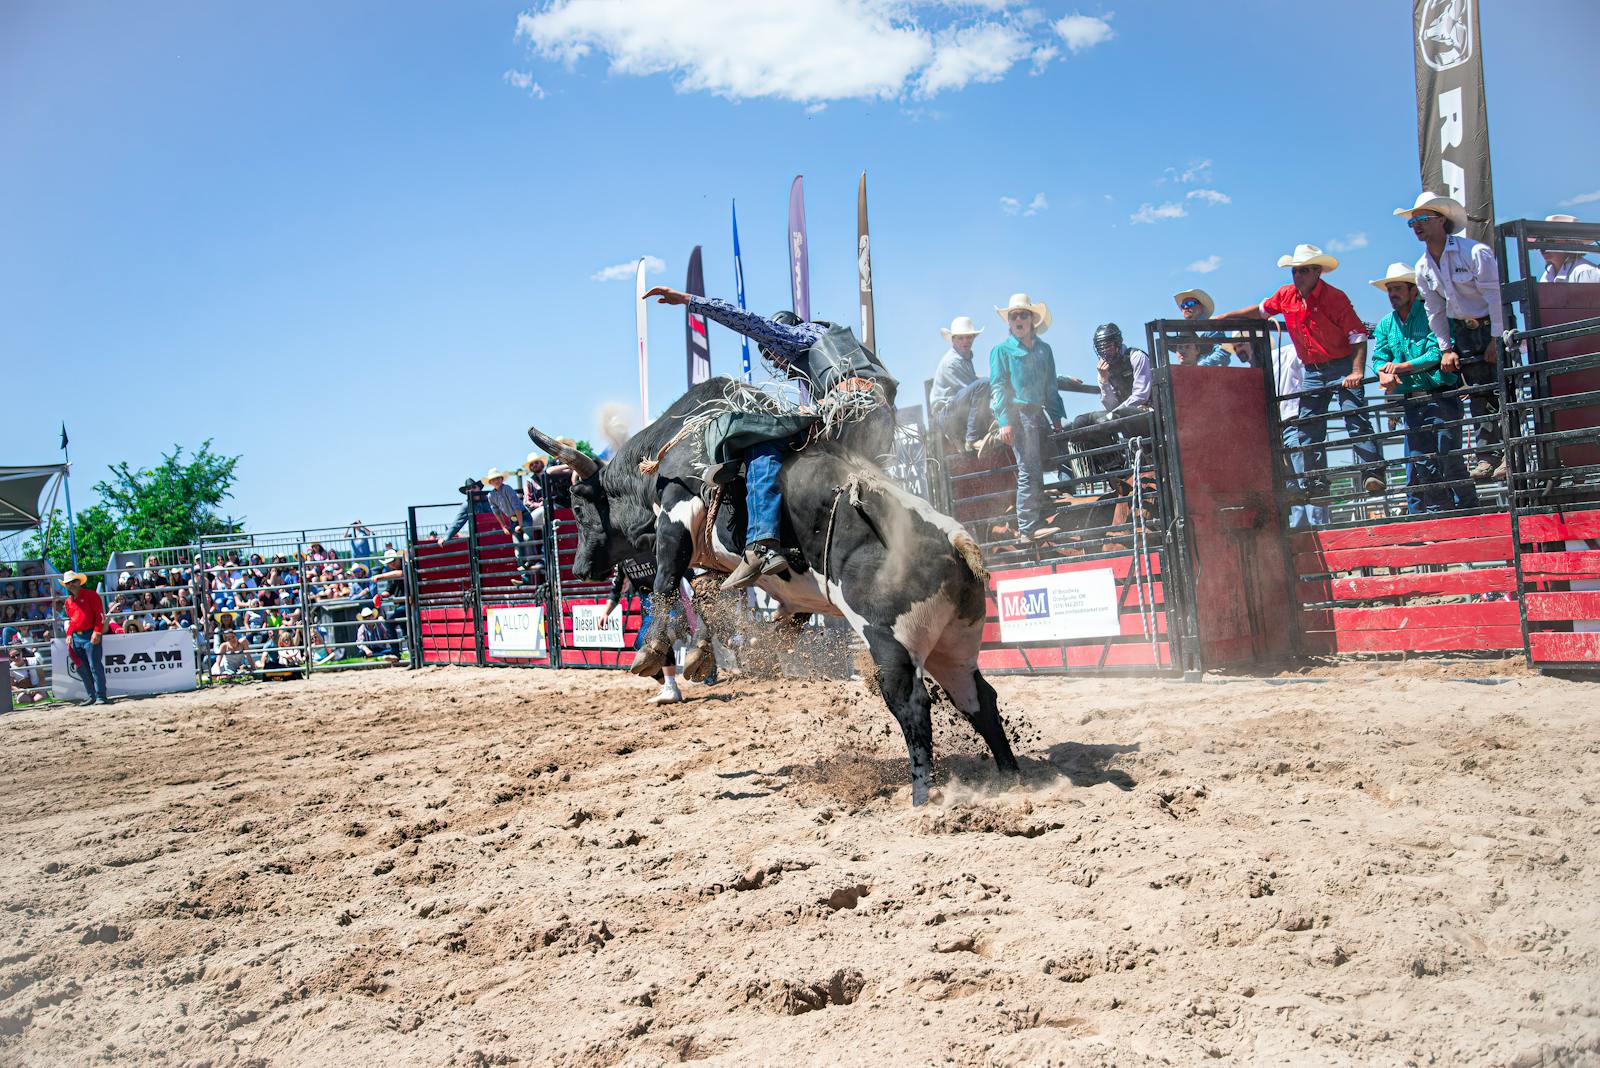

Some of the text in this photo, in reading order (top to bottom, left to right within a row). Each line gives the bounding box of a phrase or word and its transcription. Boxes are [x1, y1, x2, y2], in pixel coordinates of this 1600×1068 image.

[1003, 592, 1047, 618] M&M
[575, 616, 595, 631] Diesel
[105, 650, 182, 666] RAM
[105, 662, 183, 674] RODEO TOUR
